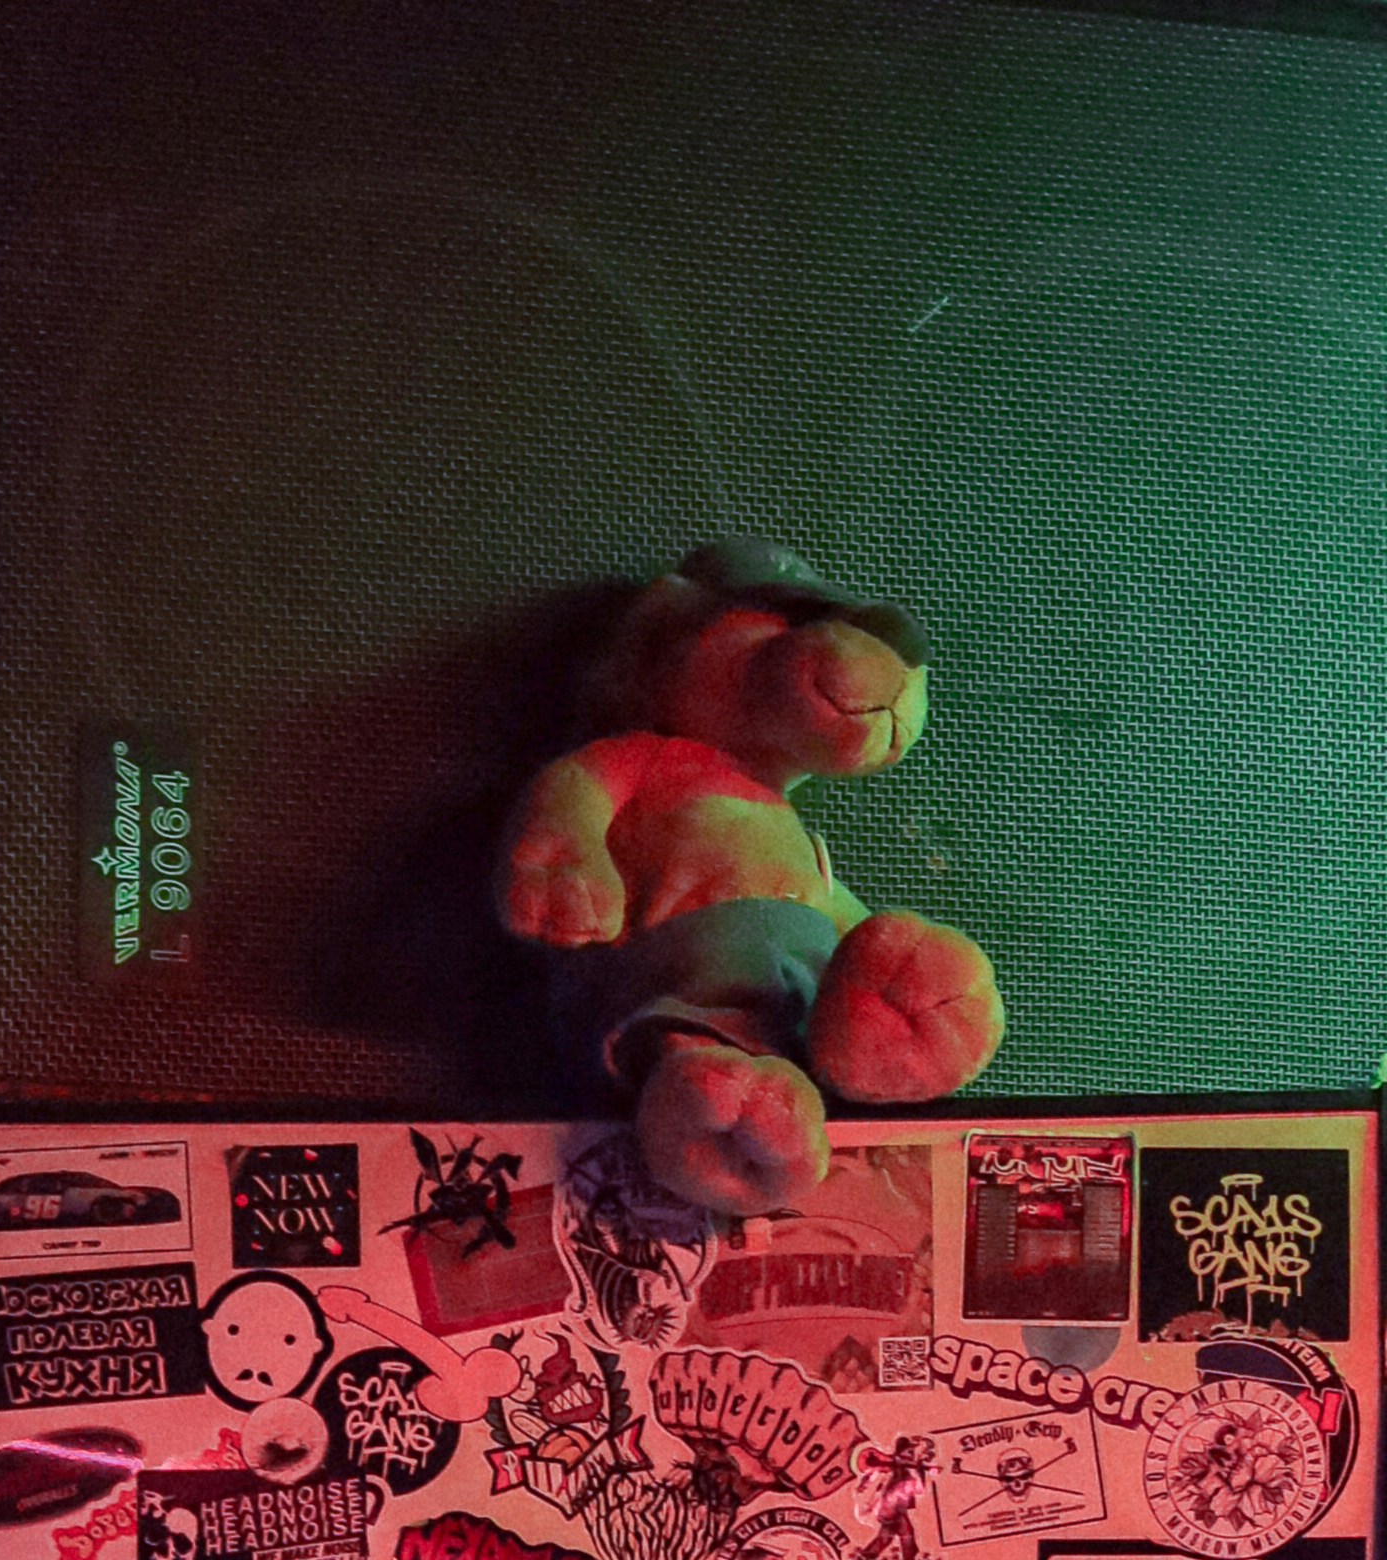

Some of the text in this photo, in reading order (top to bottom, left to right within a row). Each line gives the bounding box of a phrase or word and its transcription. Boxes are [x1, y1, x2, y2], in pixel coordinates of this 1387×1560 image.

[151, 770, 191, 912] 9064
[251, 1173, 336, 1202] NEW
[22, 1195, 63, 1220] 96
[253, 1207, 337, 1235] NOW
[1188, 1234, 1312, 1284] GANG
[7, 1319, 155, 1356] ПОЛЕВАЯ
[3, 1353, 168, 1404] КУХНЯ
[929, 1337, 1088, 1405] space
[345, 1410, 436, 1456] GANG
[1146, 1382, 1248, 1502] JOSIE MAY
[1165, 1392, 1318, 1557] MOSCOW MELODIC HARDCORE
[199, 1479, 359, 1517] HEADNOISE
[202, 1499, 362, 1536] HEADNOISE
[204, 1517, 364, 1556] HEADNOISE
[735, 1514, 770, 1542] CITY
[775, 1511, 821, 1529] FIGHT
[283, 1546, 315, 1560] MAKE
